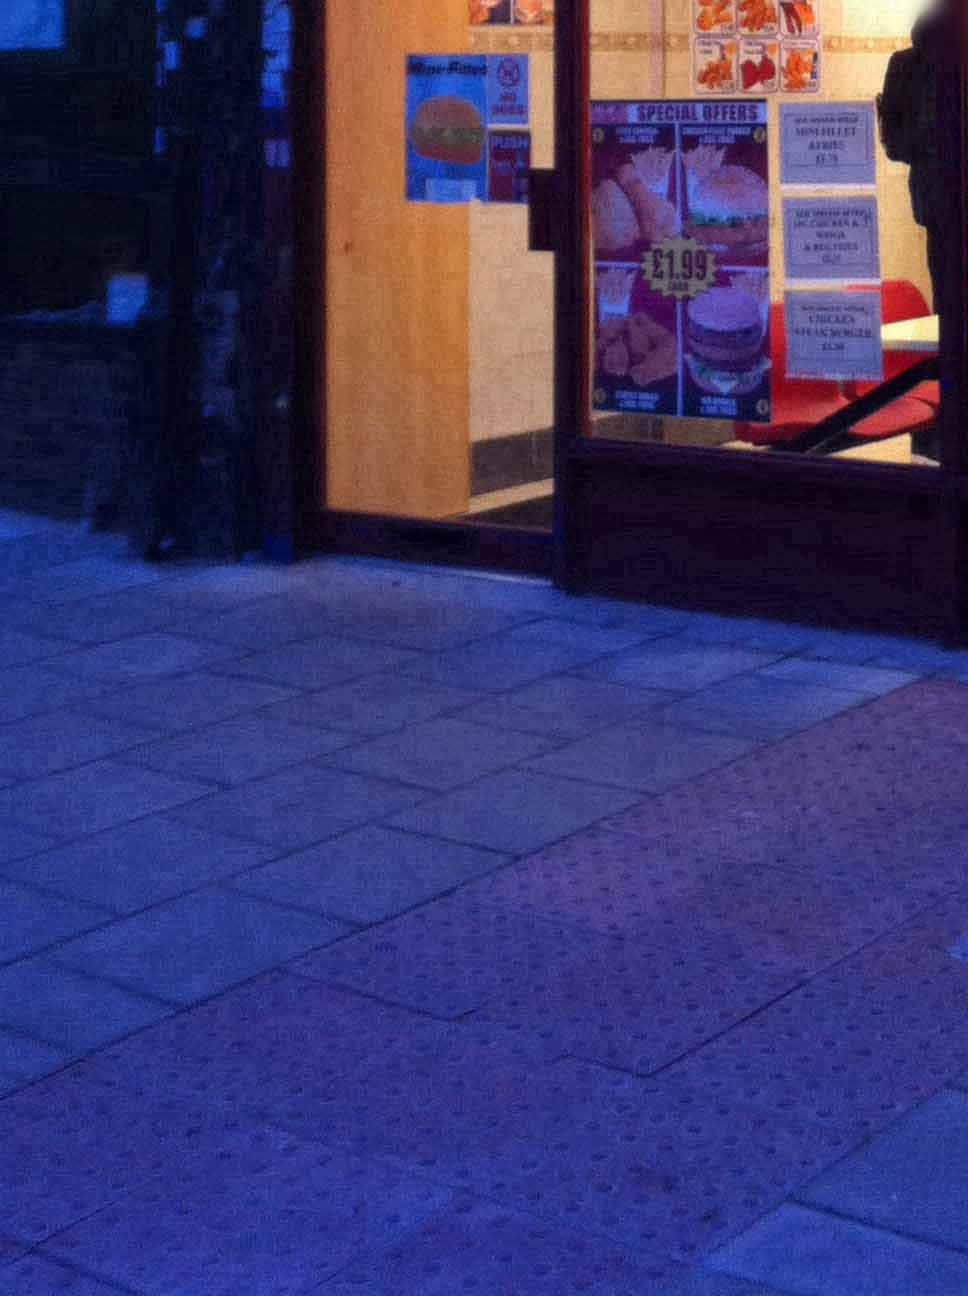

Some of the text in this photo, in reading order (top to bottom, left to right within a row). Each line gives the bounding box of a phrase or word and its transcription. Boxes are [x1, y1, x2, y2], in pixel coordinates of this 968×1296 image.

[637, 104, 698, 121] SPECIAL
[702, 104, 758, 121] OFFERS
[652, 249, 708, 280] £1.99
